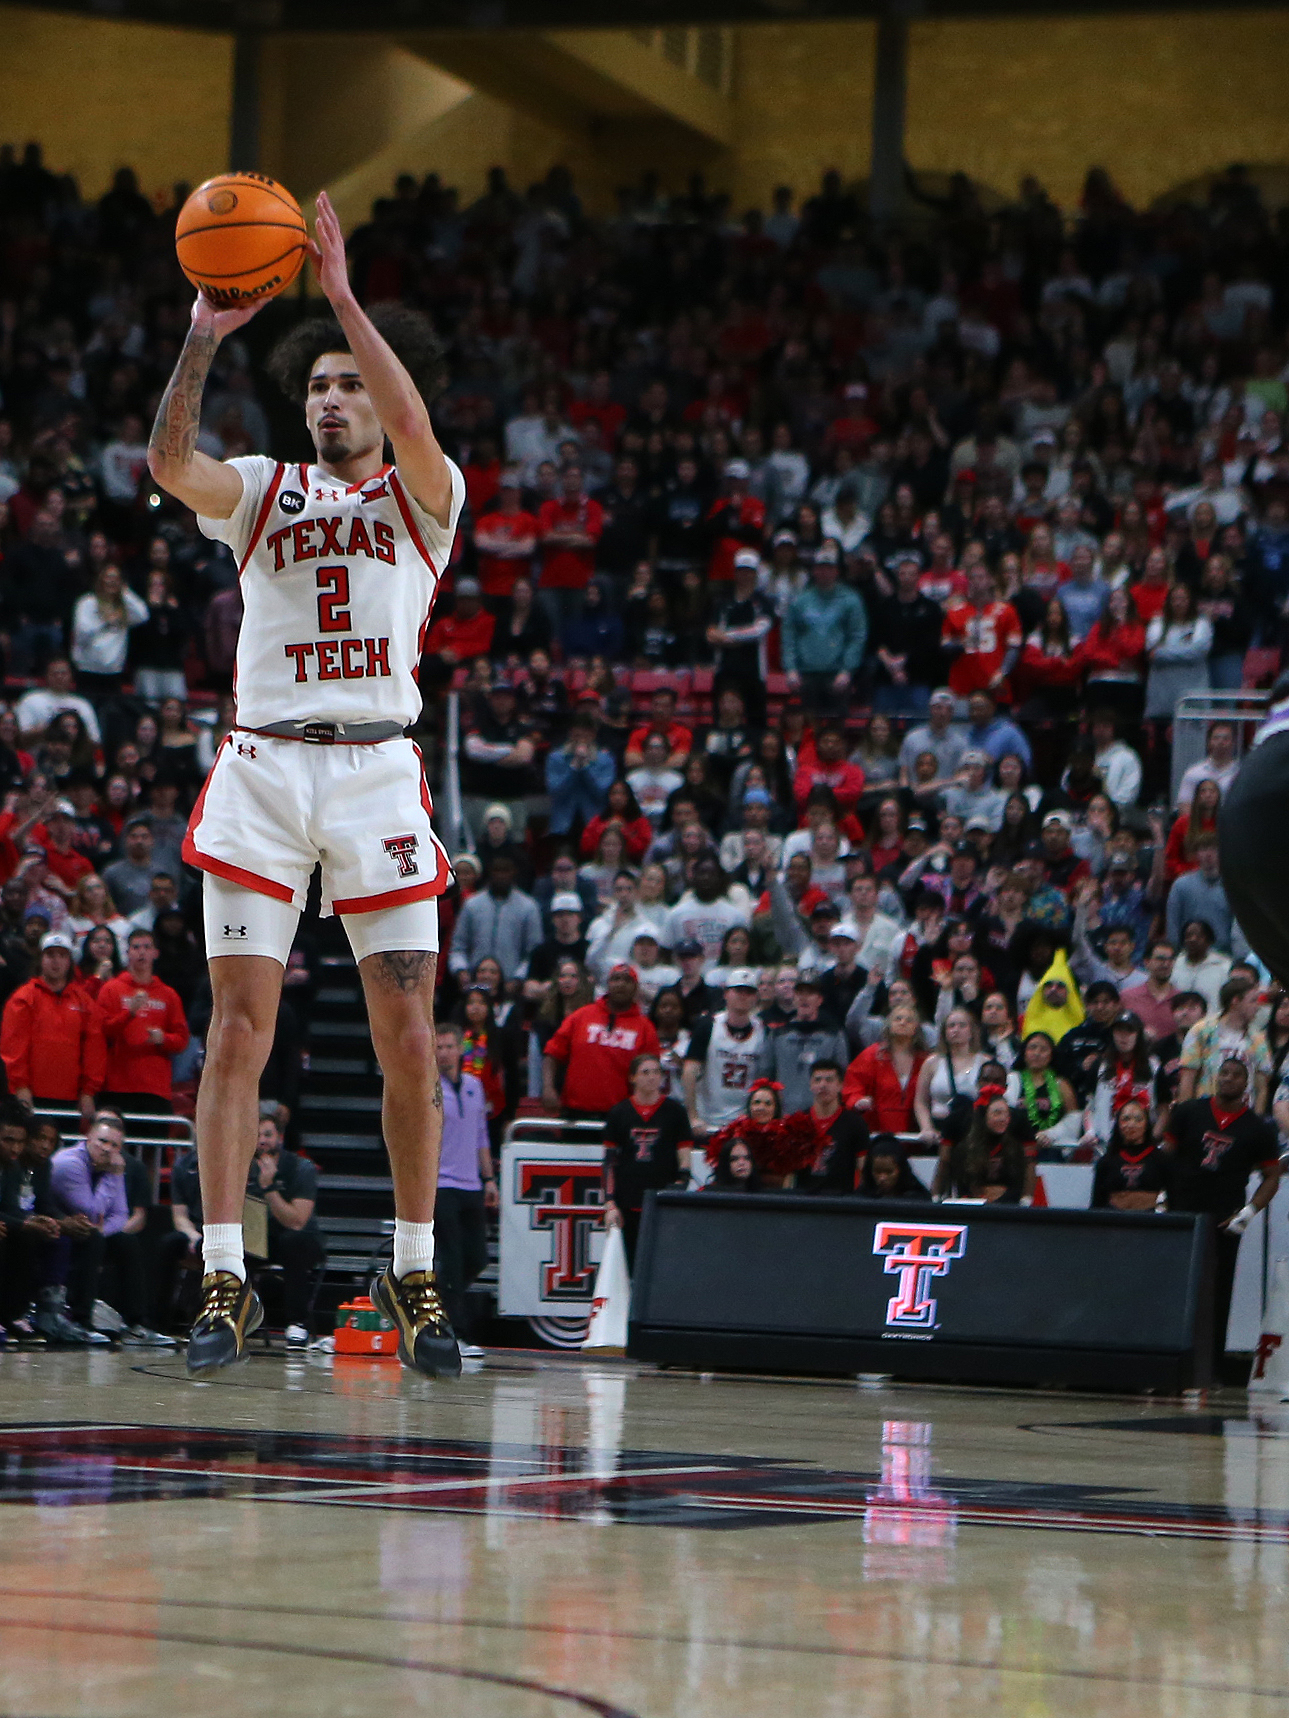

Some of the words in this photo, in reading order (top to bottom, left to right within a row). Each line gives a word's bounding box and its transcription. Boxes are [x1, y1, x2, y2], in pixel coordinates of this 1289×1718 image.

[281, 496, 302, 510] BK
[266, 516, 396, 573] TEXAS
[316, 565, 352, 634] 2
[284, 637, 392, 684] TECH
